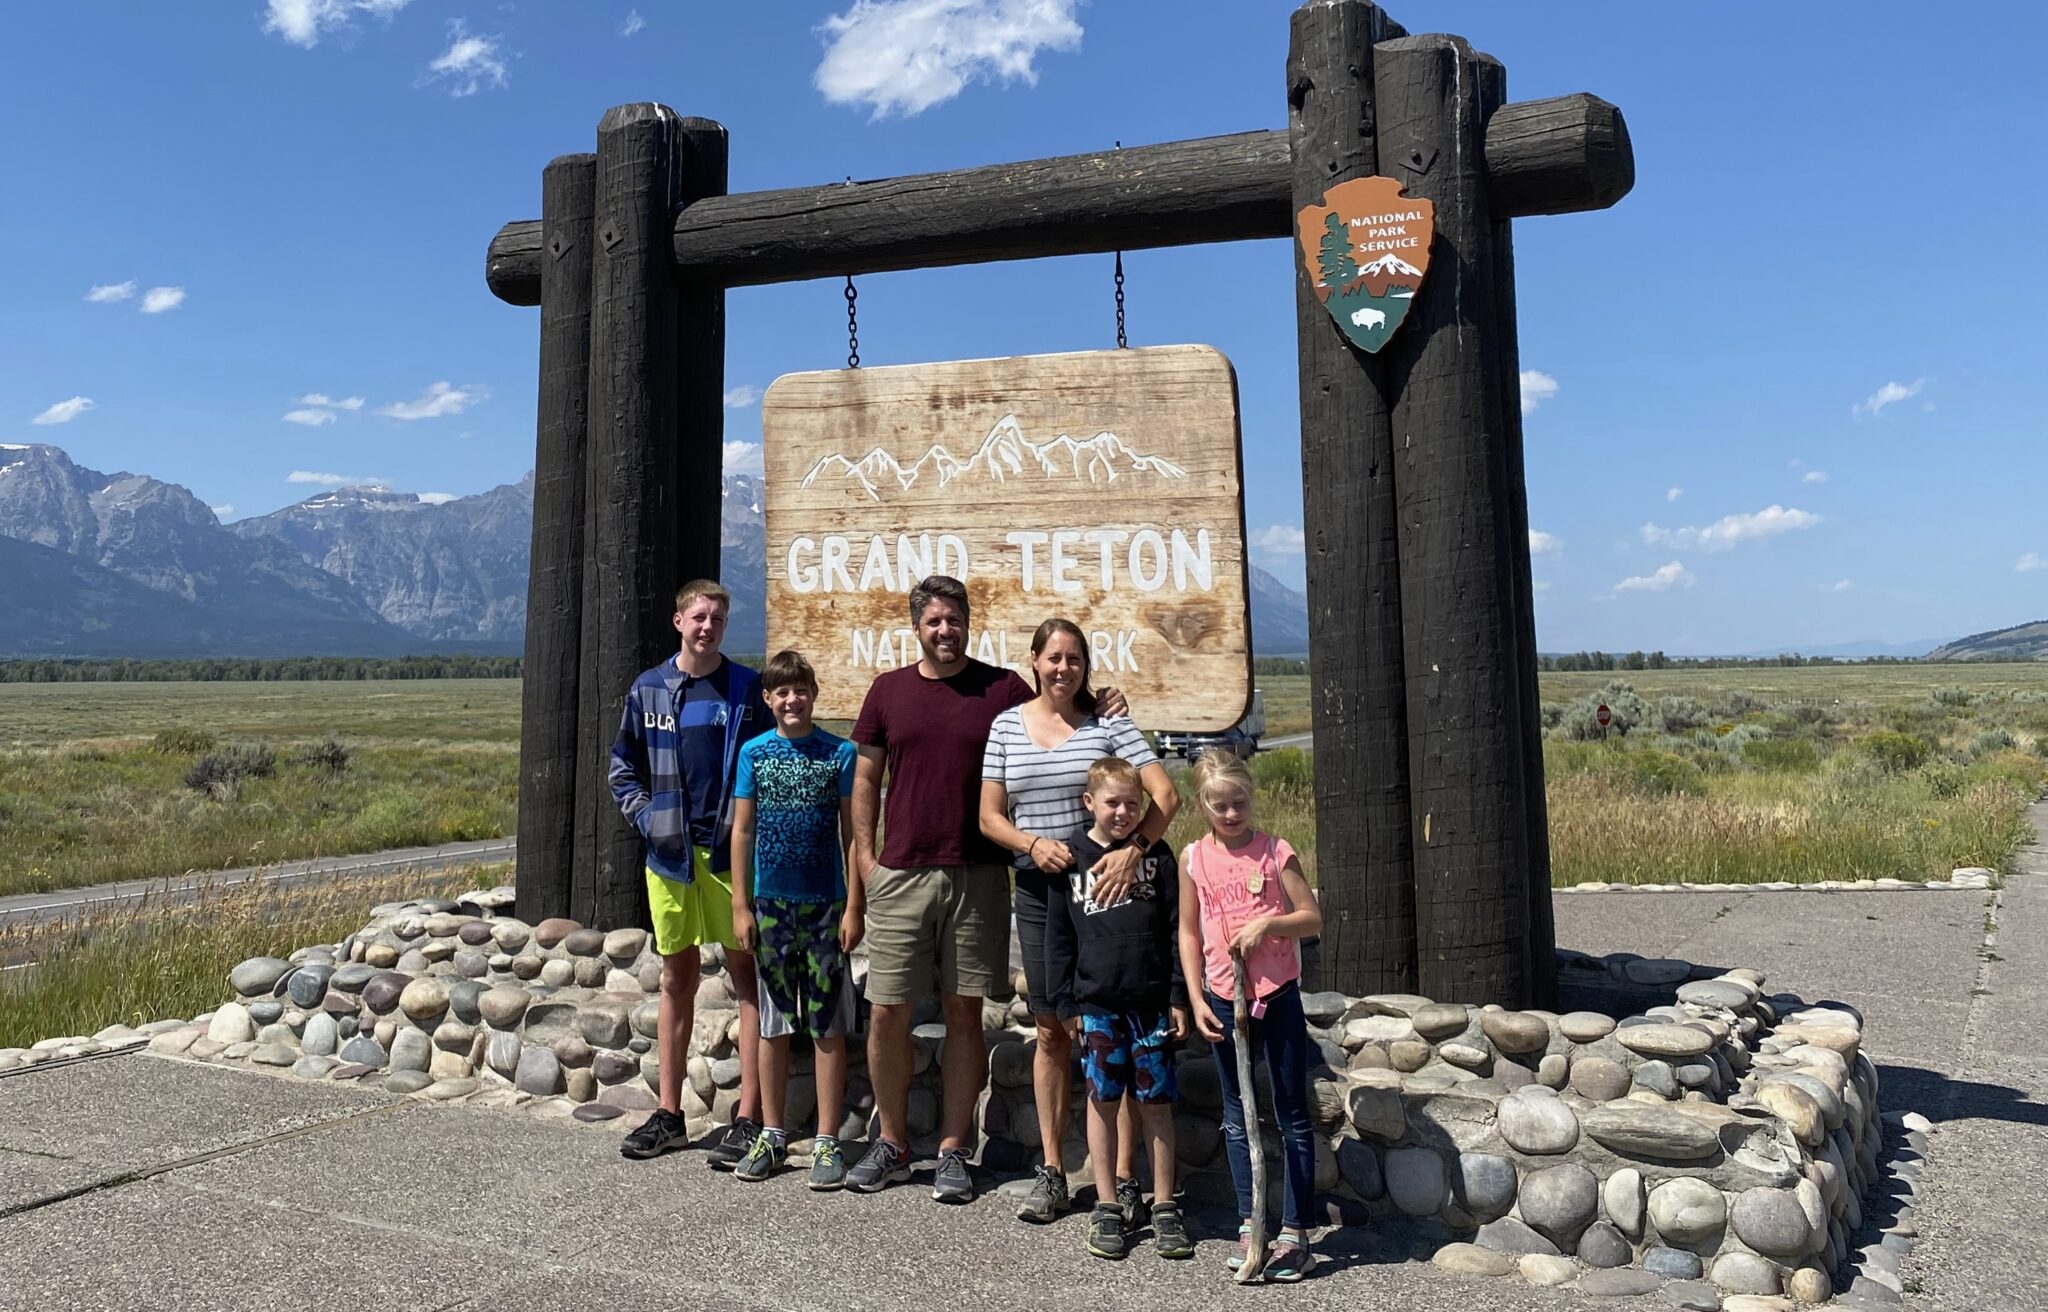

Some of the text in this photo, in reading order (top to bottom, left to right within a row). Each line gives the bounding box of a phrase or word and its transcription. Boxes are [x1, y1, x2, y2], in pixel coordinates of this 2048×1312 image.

[1351, 211, 1424, 227] NATIONAL
[1368, 225, 1406, 238] PARK
[1359, 237, 1419, 253] SERVICE
[787, 528, 1212, 592] GRAND TETON
[851, 628, 1139, 672] NATAL RK
[1597, 710, 1611, 721] STOP
[1068, 857, 1158, 904] RANS
